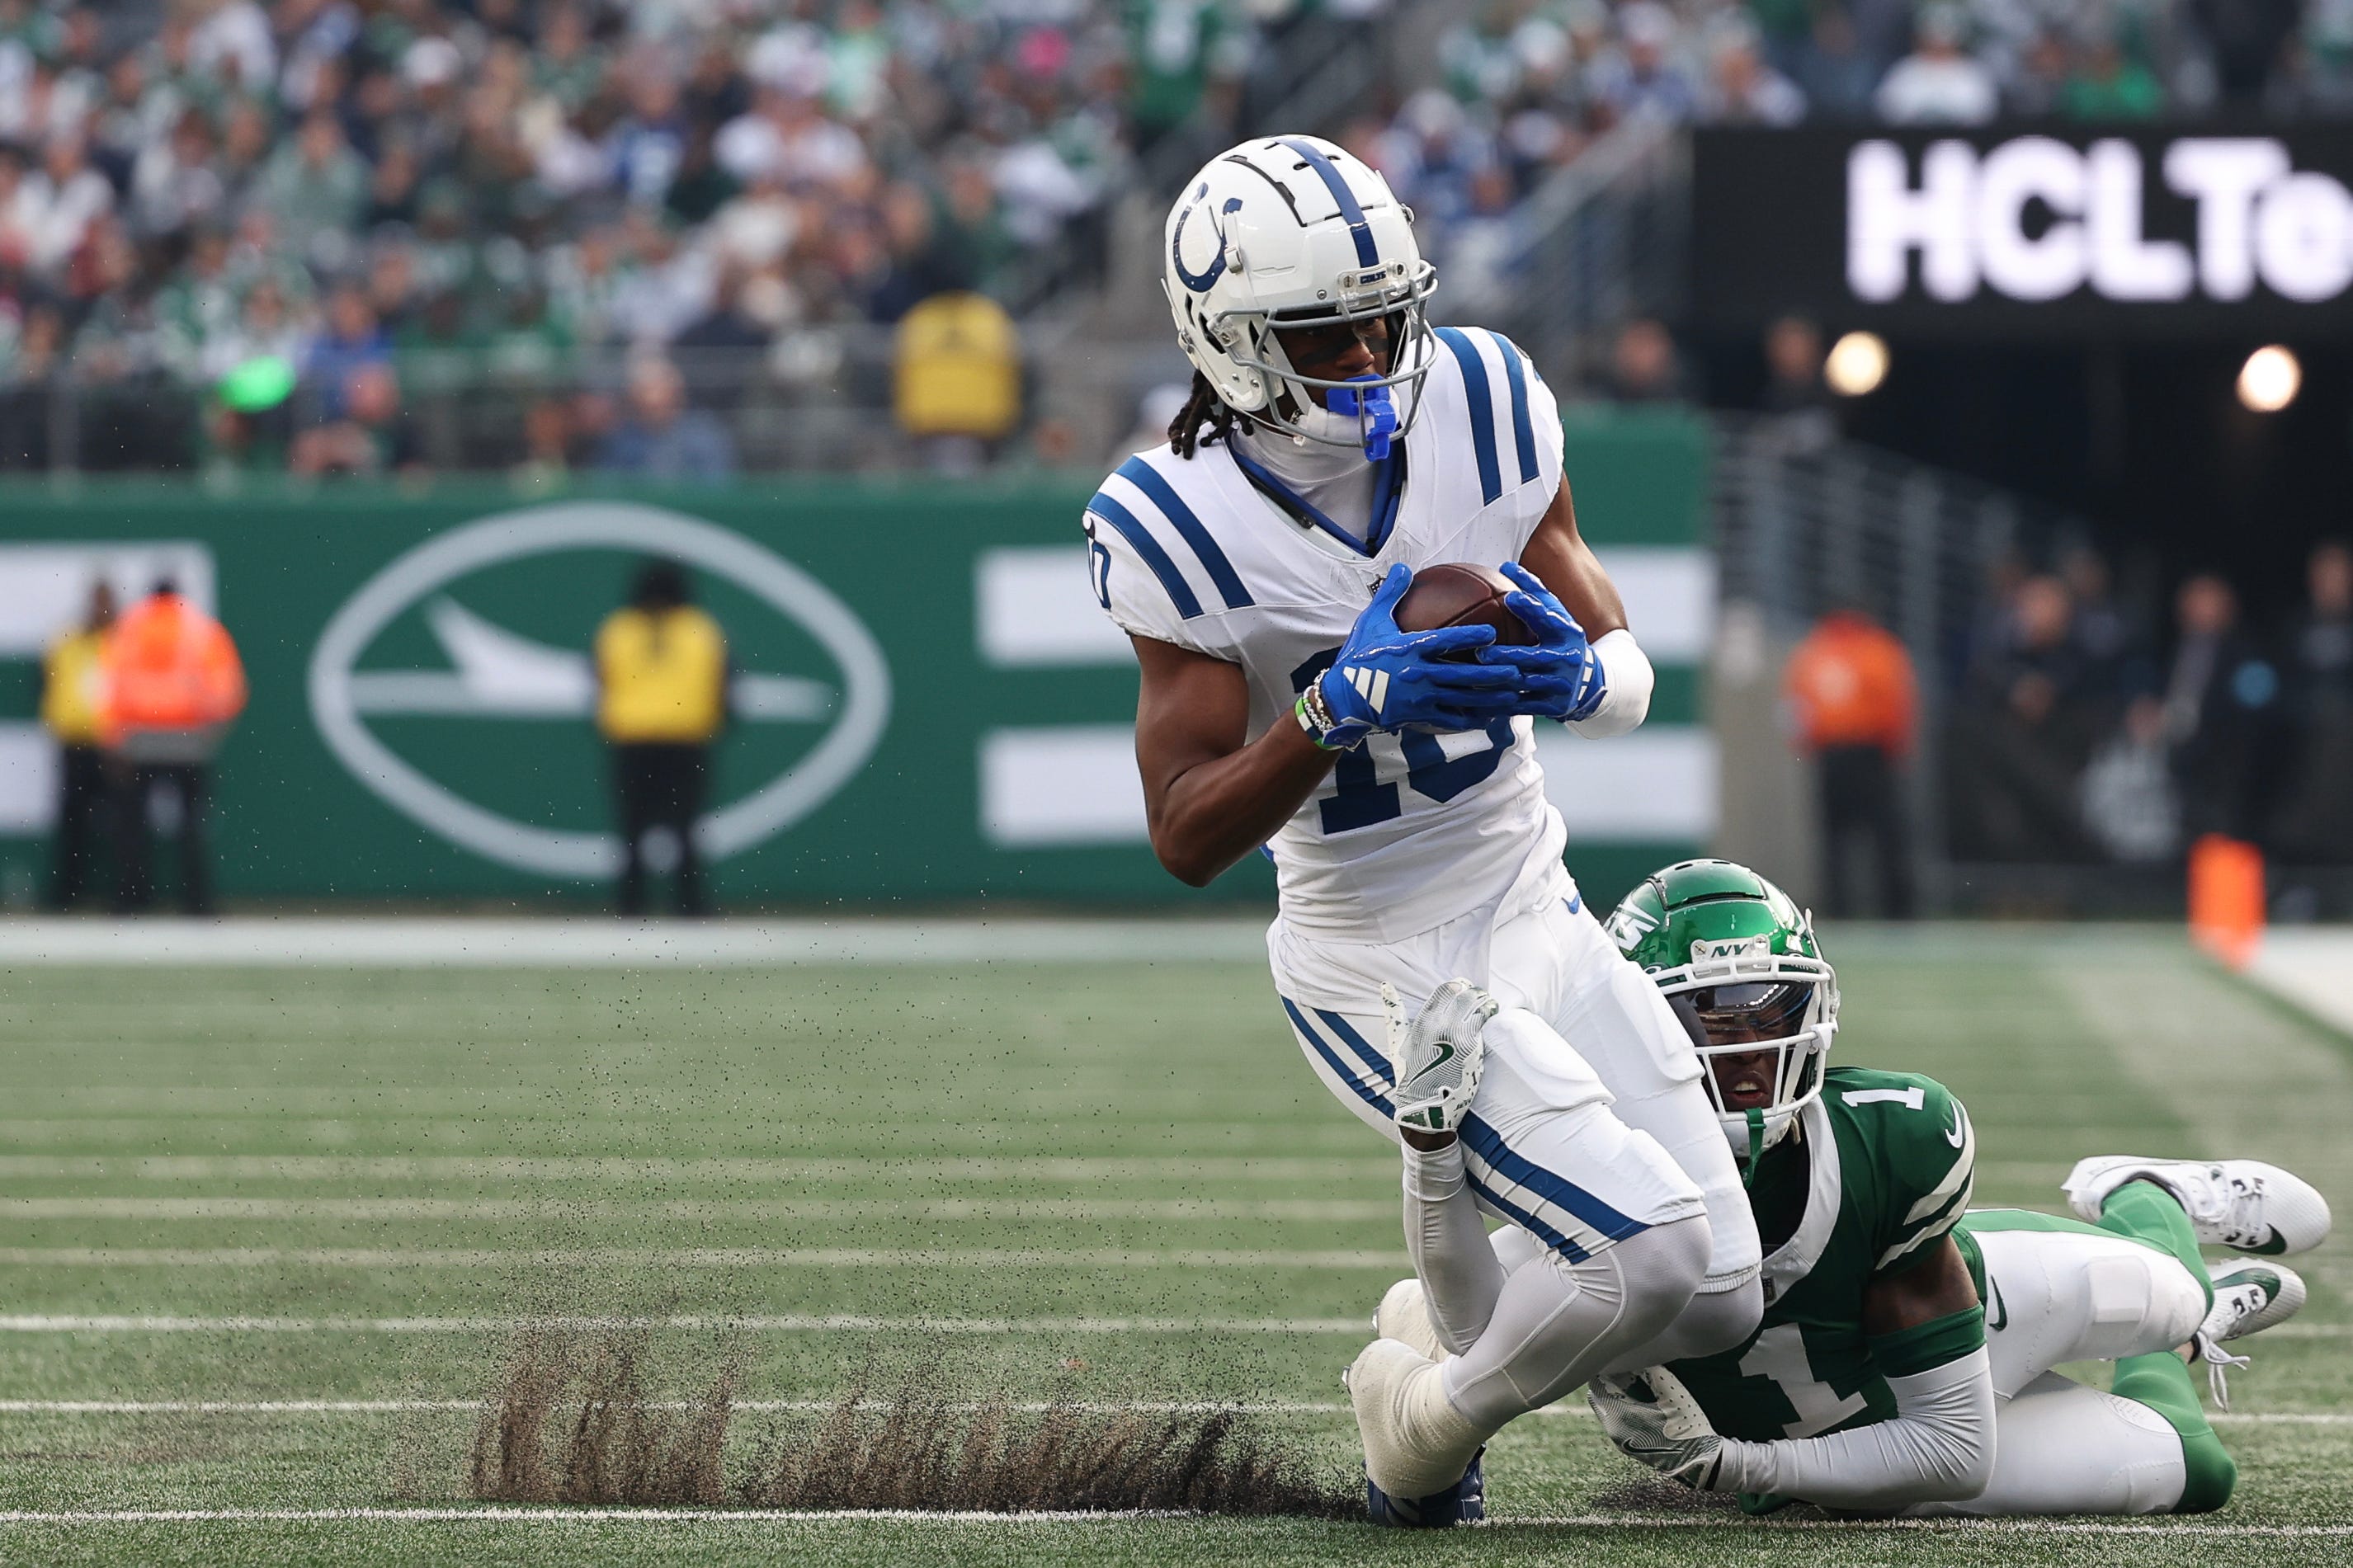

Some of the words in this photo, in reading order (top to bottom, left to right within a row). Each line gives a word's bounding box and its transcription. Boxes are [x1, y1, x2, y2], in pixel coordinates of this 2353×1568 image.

[1711, 944, 1748, 958] NY
[1841, 1086, 1925, 1111] 1
[1738, 1322, 1868, 1439] 1
